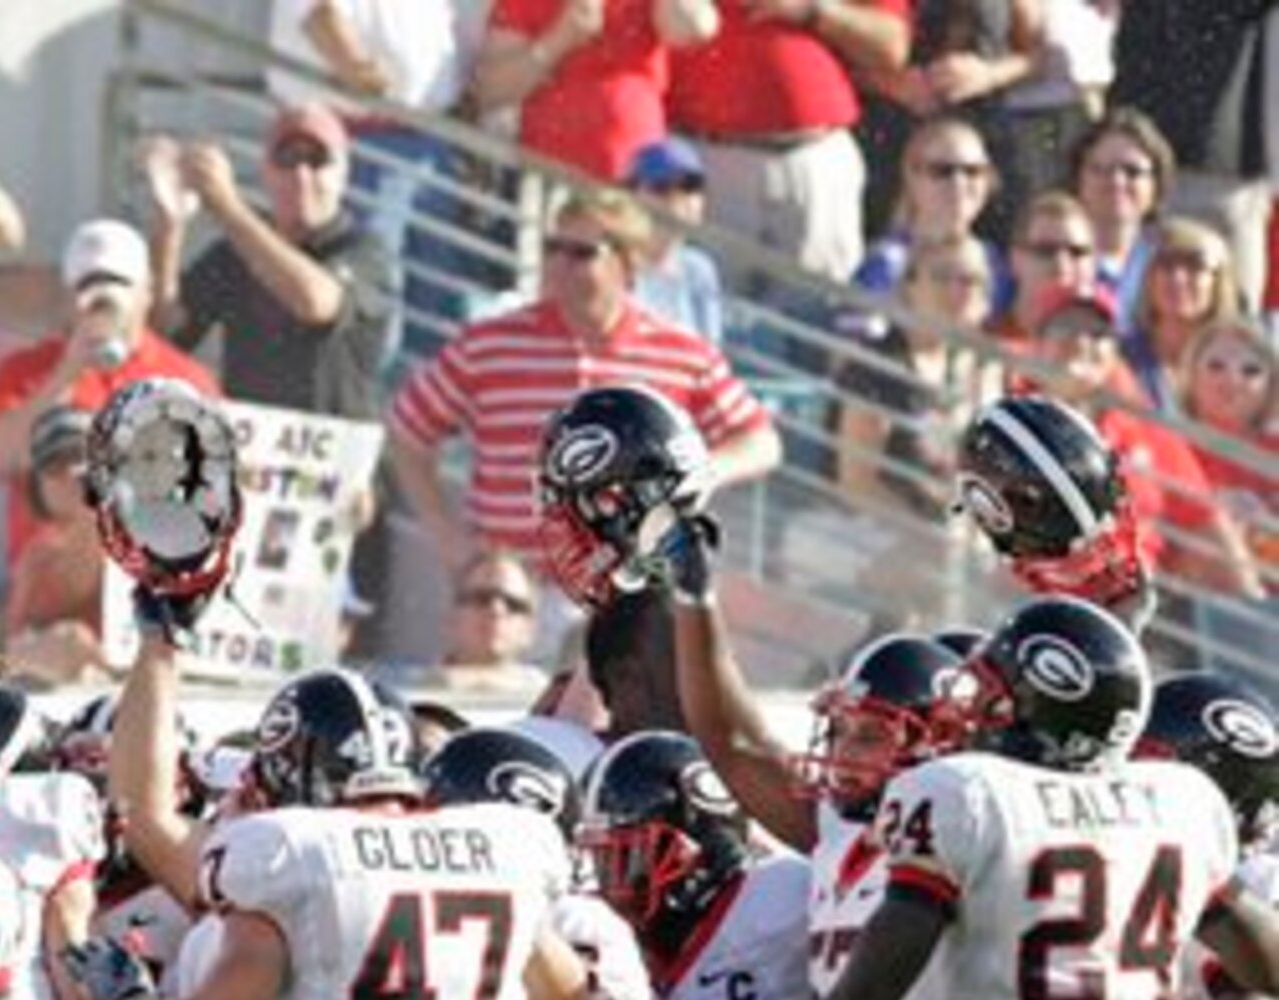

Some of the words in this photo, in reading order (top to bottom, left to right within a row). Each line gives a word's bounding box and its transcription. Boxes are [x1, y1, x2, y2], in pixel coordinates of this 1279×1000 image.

[881, 799, 934, 857] 24
[1035, 780, 1161, 832] EALEY
[352, 827, 497, 873] GLOER
